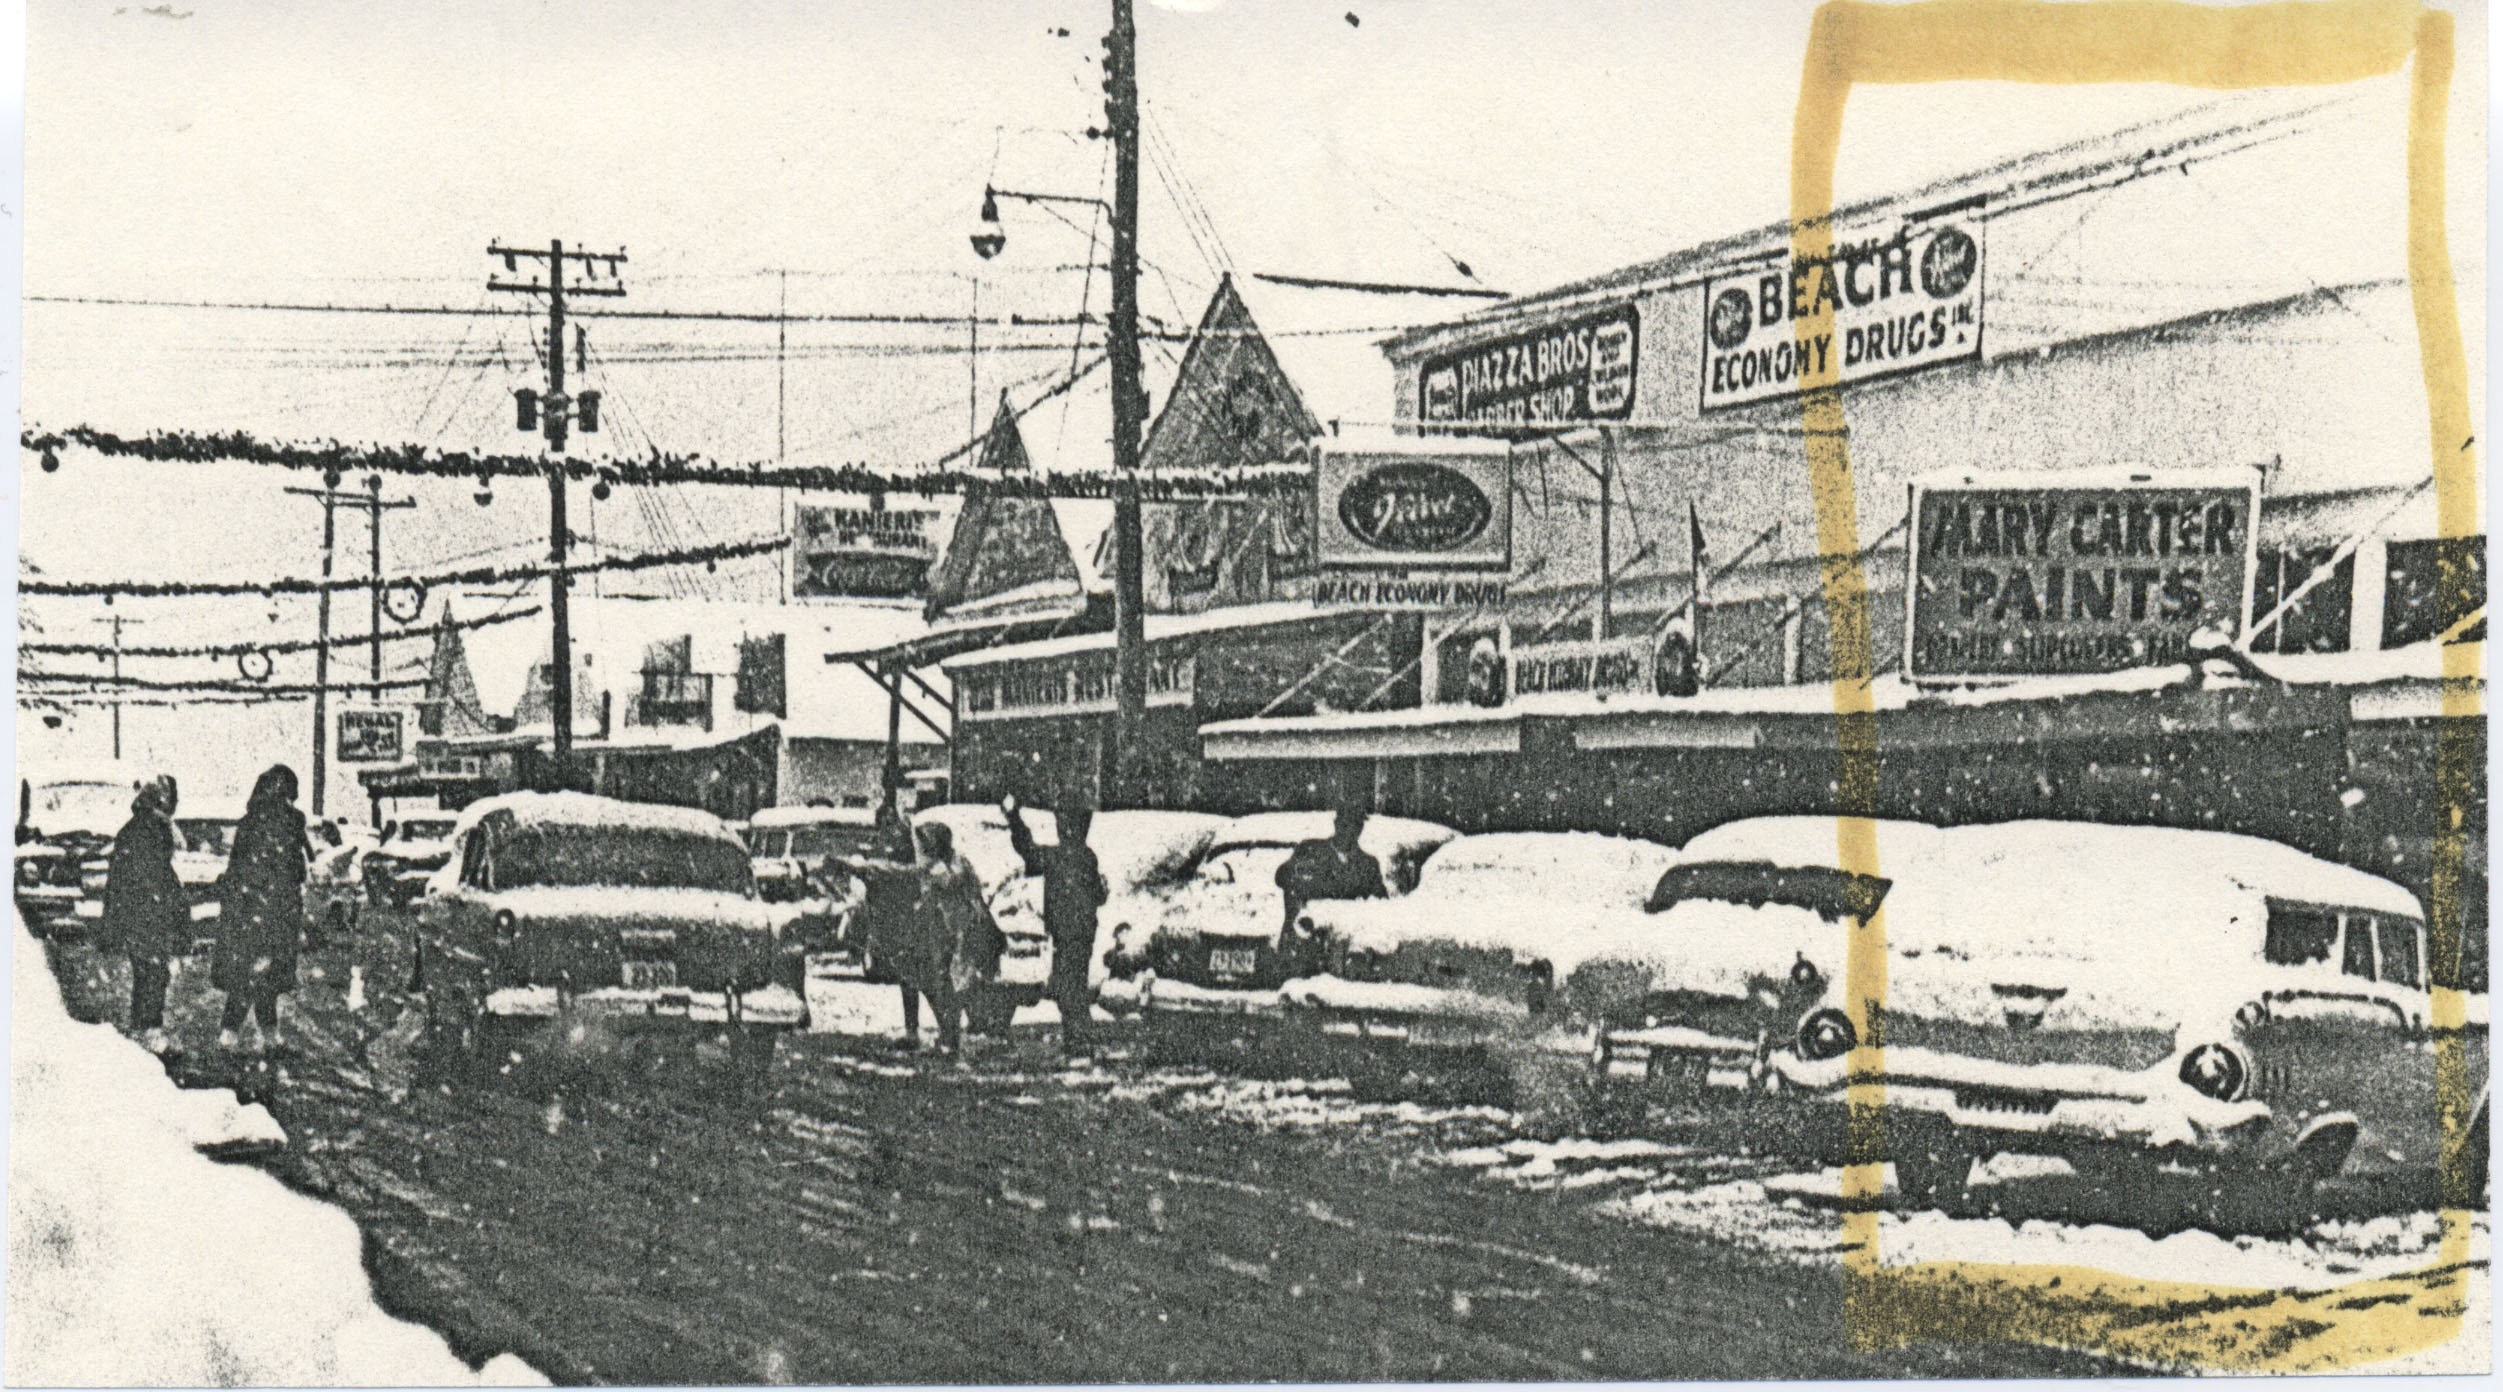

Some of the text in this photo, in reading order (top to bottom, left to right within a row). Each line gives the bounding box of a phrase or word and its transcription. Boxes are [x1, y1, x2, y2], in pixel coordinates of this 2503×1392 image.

[1759, 240, 1914, 328] BEACH
[1461, 344, 1535, 395] PIAZZA
[1537, 327, 1590, 383] BROS
[1711, 333, 1832, 394] ECONOMY
[1844, 305, 1947, 368] DRUGS
[1529, 384, 1576, 422] SHOP
[1930, 499, 2237, 556] MARY CARTER
[1960, 566, 2203, 621] PAINTS
